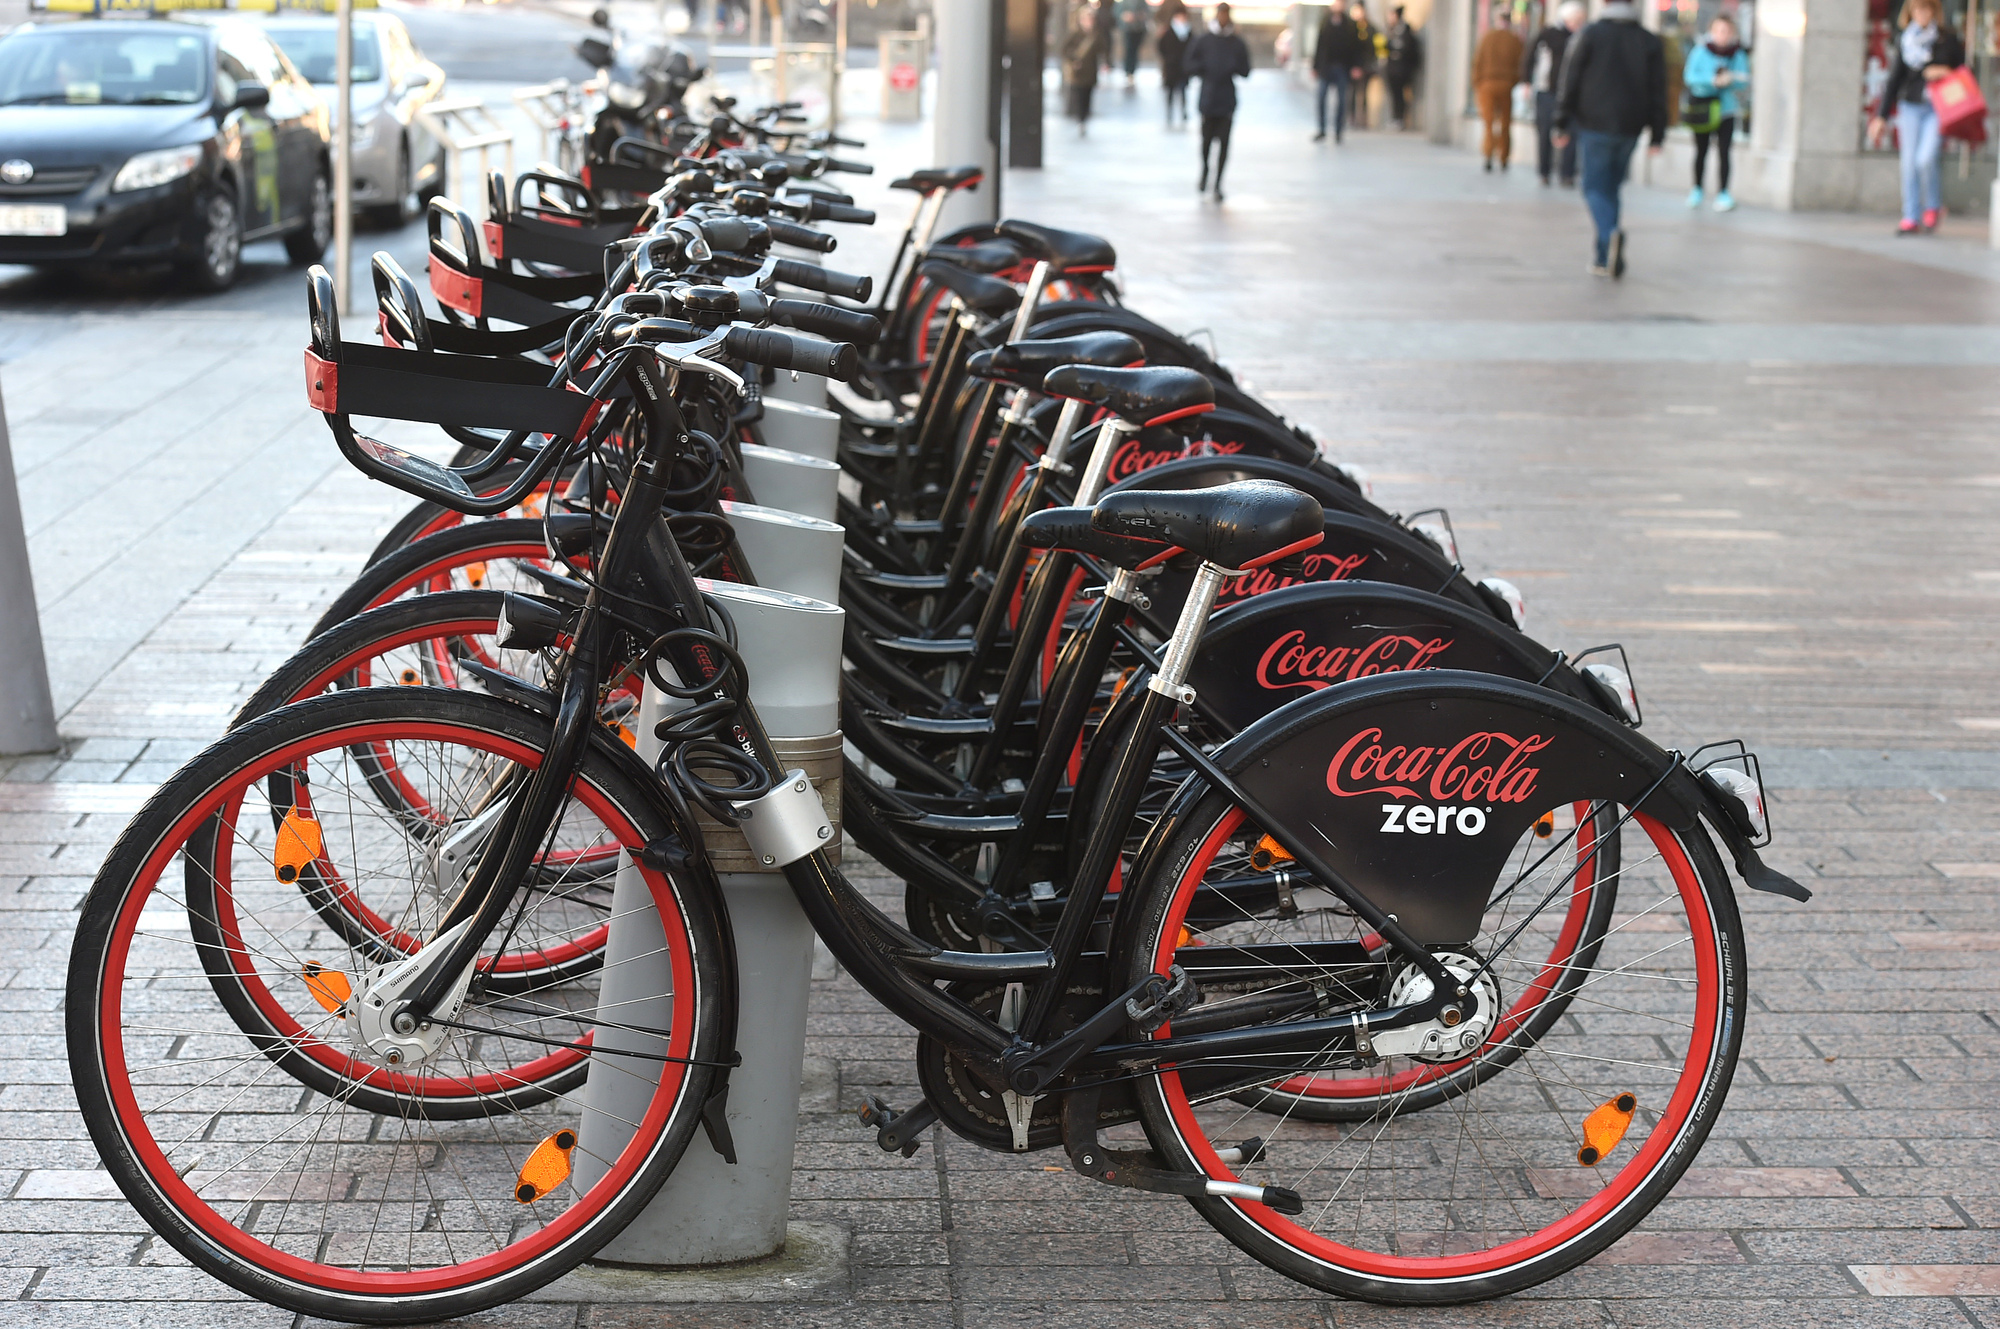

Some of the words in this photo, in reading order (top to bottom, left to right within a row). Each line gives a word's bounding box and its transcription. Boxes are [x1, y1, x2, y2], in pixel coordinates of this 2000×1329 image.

[1326, 727, 1556, 803] Coca-Cola
[1379, 804, 1487, 836] zero
[389, 964, 420, 989] SHIMANO
[1719, 931, 1734, 1005] SCHWALBE
[441, 1012, 456, 1034] INER
[1695, 1057, 1725, 1122] MARATHON
[1674, 1123, 1696, 1156] PLUS
